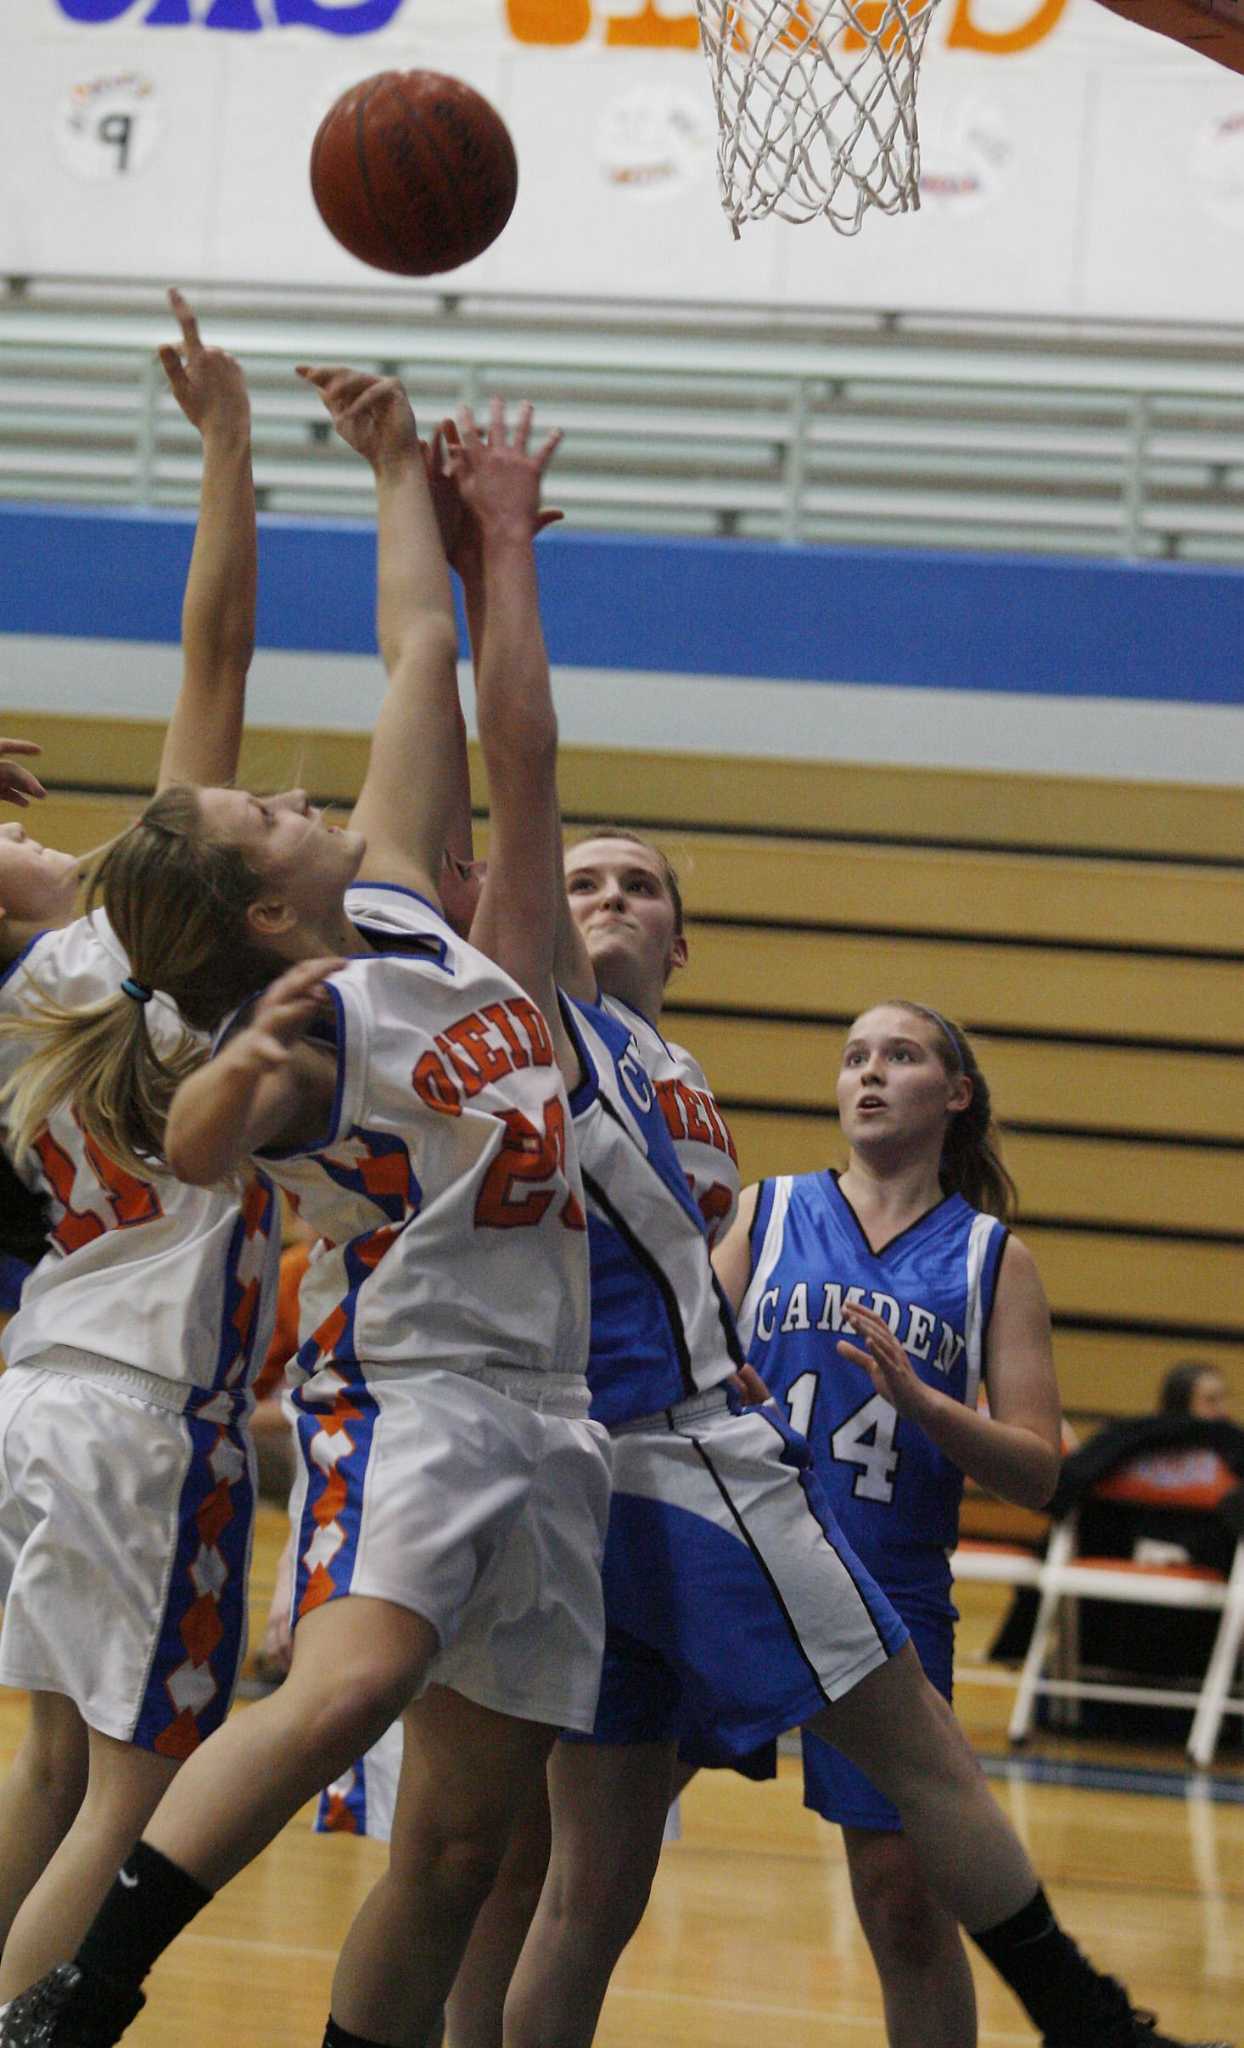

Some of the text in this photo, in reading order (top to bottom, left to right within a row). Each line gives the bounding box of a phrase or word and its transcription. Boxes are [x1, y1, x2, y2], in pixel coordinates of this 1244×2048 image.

[98, 112, 133, 174] 9
[757, 1282, 966, 1377] CAMDEN
[786, 1370, 899, 1505] 14
